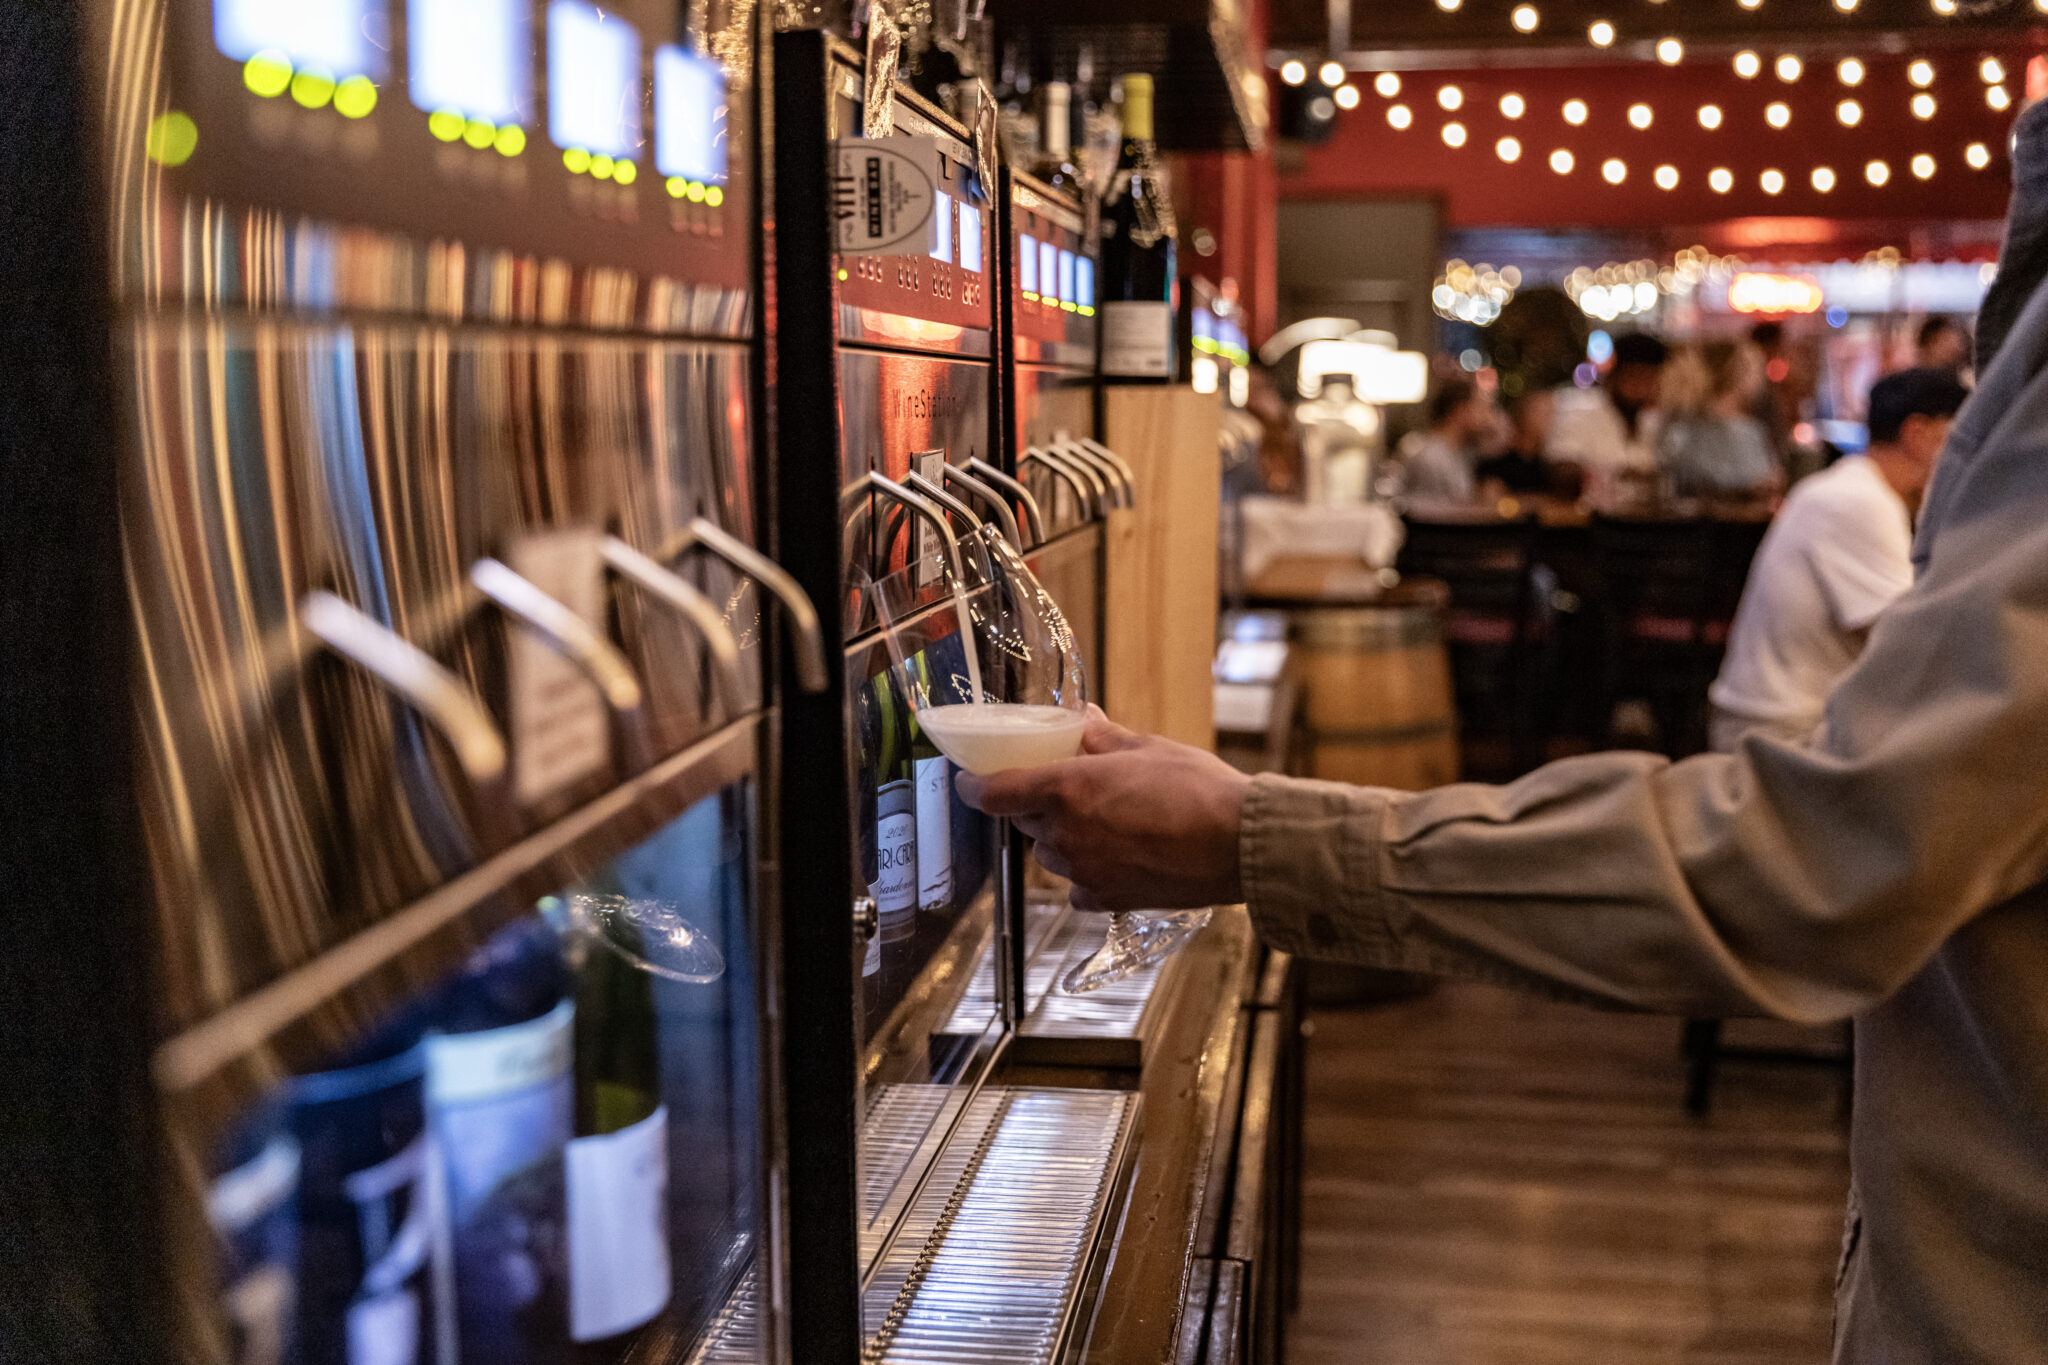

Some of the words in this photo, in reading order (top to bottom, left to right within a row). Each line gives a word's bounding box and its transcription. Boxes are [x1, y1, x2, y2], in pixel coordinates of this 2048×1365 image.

[868, 160, 879, 190] BAR
[870, 198, 880, 235] WINE
[892, 387, 957, 419] WineStation
